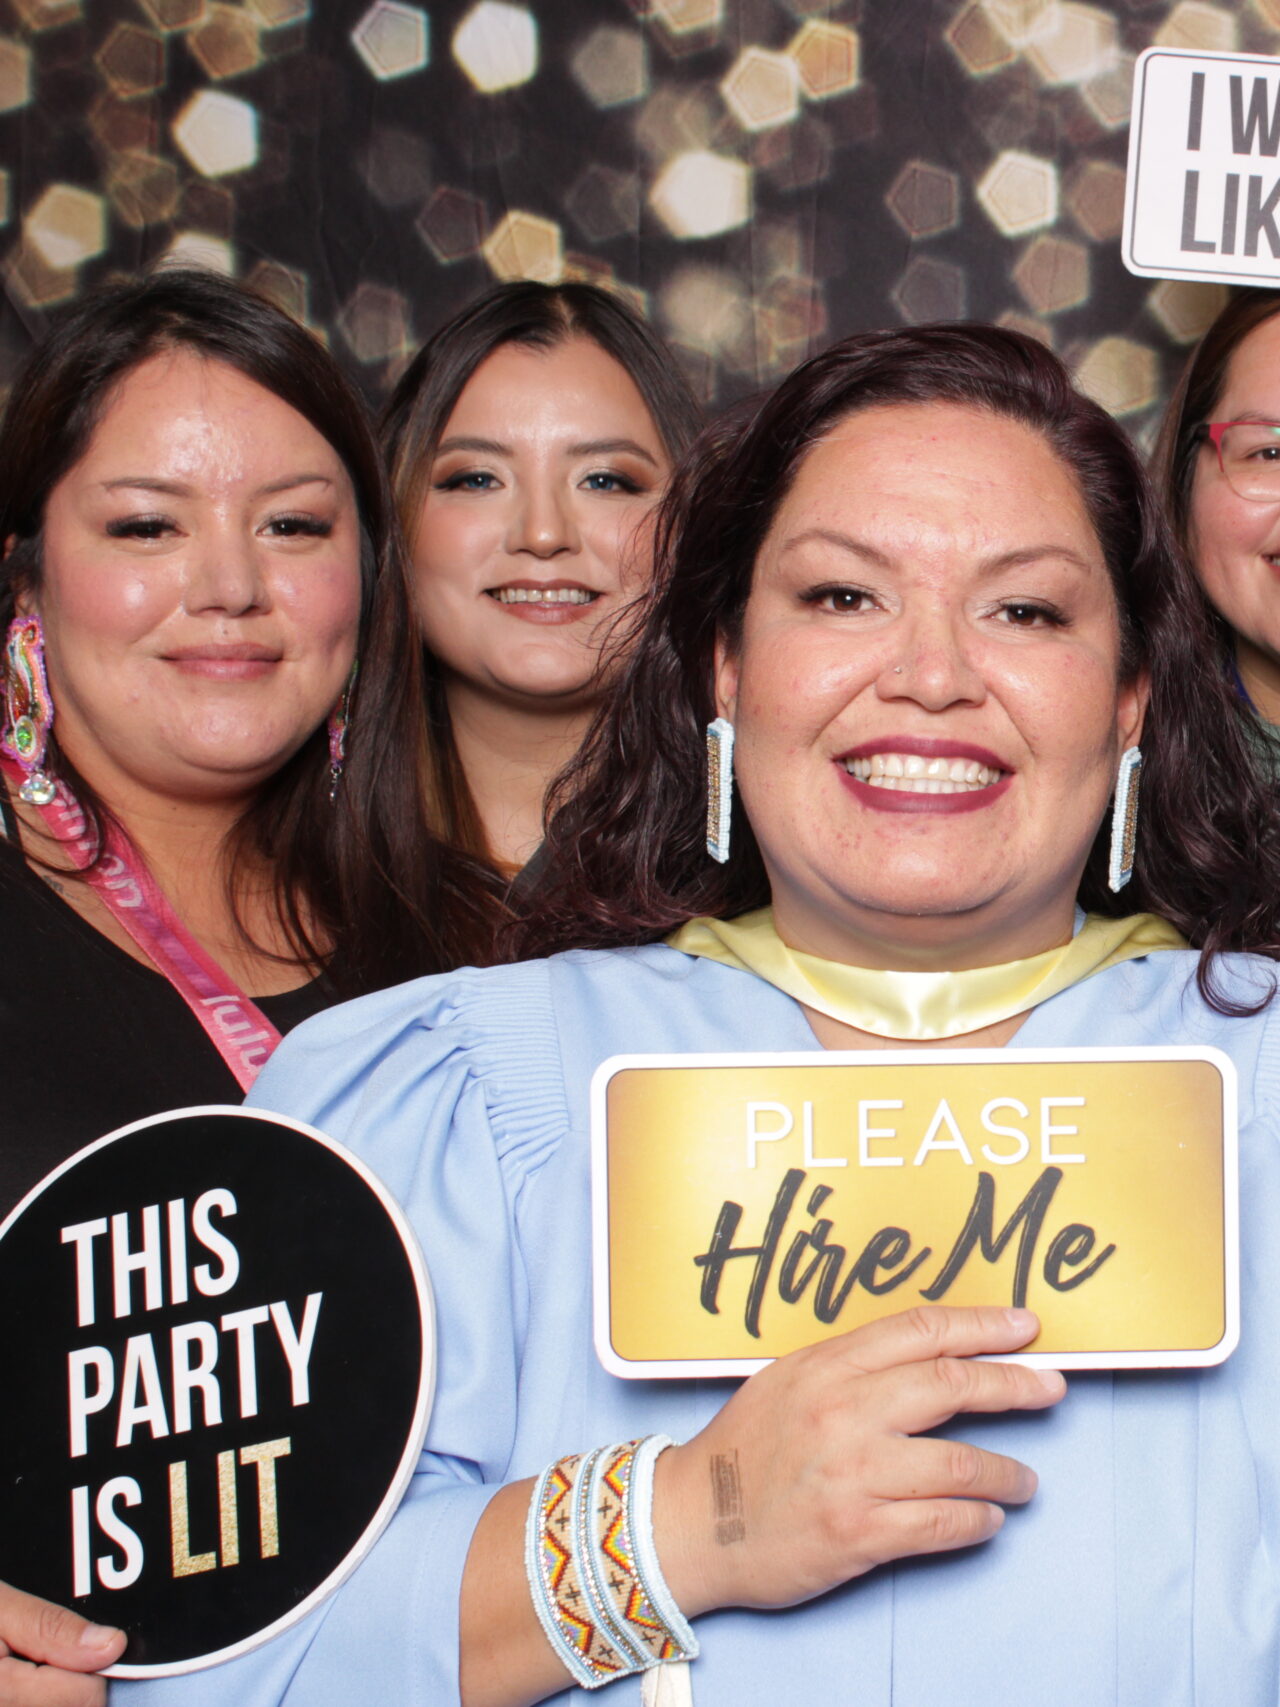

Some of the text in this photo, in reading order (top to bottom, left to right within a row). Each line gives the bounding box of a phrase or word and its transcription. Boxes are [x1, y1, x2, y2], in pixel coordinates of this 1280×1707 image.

[1187, 72, 1206, 151] I
[746, 1096, 1086, 1169] PLEASE
[61, 1187, 240, 1328] THIS
[694, 1165, 1117, 1338] Hire Me
[67, 1291, 323, 1458] PARTY
[71, 1436, 292, 1598] IS LIT
